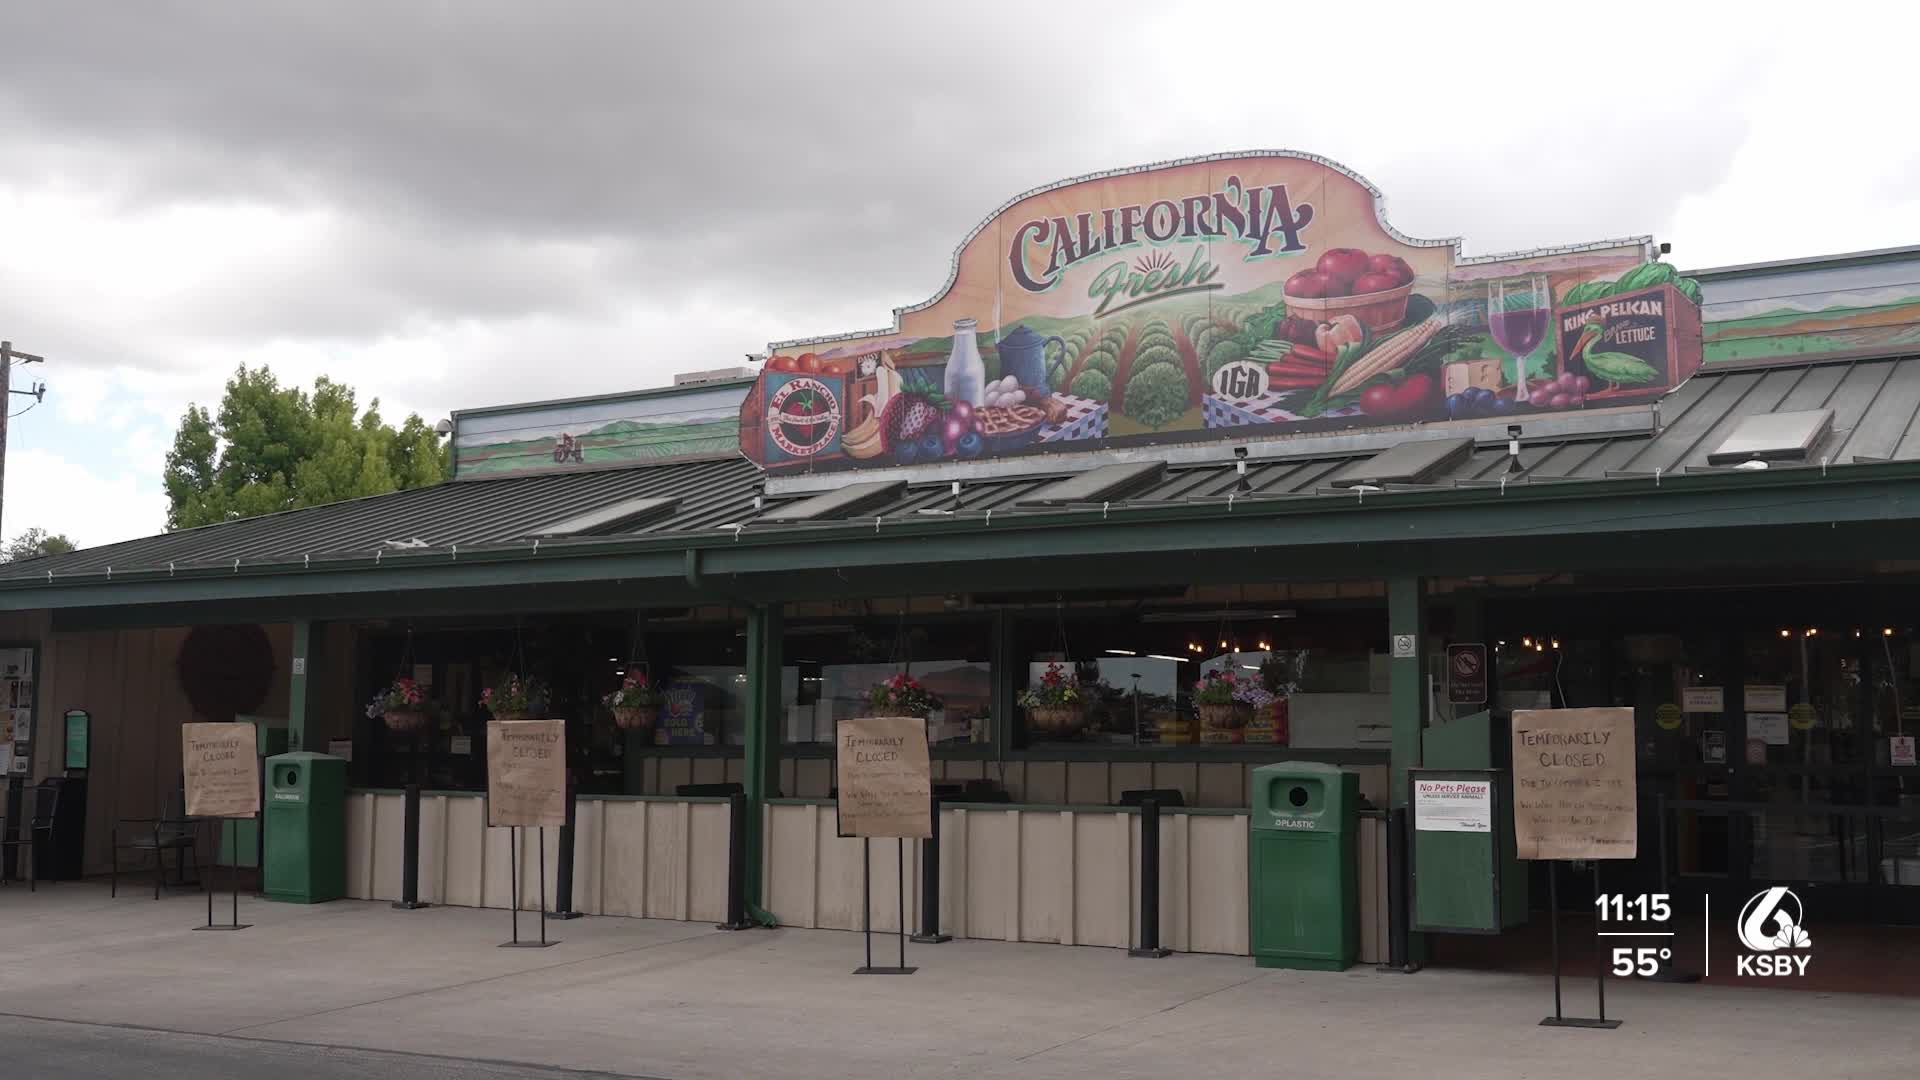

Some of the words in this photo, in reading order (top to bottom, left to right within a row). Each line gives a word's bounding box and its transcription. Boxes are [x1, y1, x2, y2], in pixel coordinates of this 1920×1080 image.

[1009, 175, 1314, 293] CALIFORNIA
[1088, 244, 1220, 318] Fresh
[1600, 300, 1663, 319] PELICAN
[1615, 326, 1656, 344] LETTUCE
[1220, 365, 1260, 399] IGA
[771, 391, 790, 409] EL
[789, 380, 836, 410] RANCHO
[772, 424, 836, 455] MARKETPLACE
[1517, 730, 1610, 746] TEMPORARILY
[856, 751, 898, 762] CLOSED
[1539, 752, 1605, 767] CLOSED
[1419, 783, 1432, 791] No
[1434, 783, 1454, 792] Pets
[1456, 784, 1487, 793] Please
[1281, 819, 1314, 829] PLASTIC
